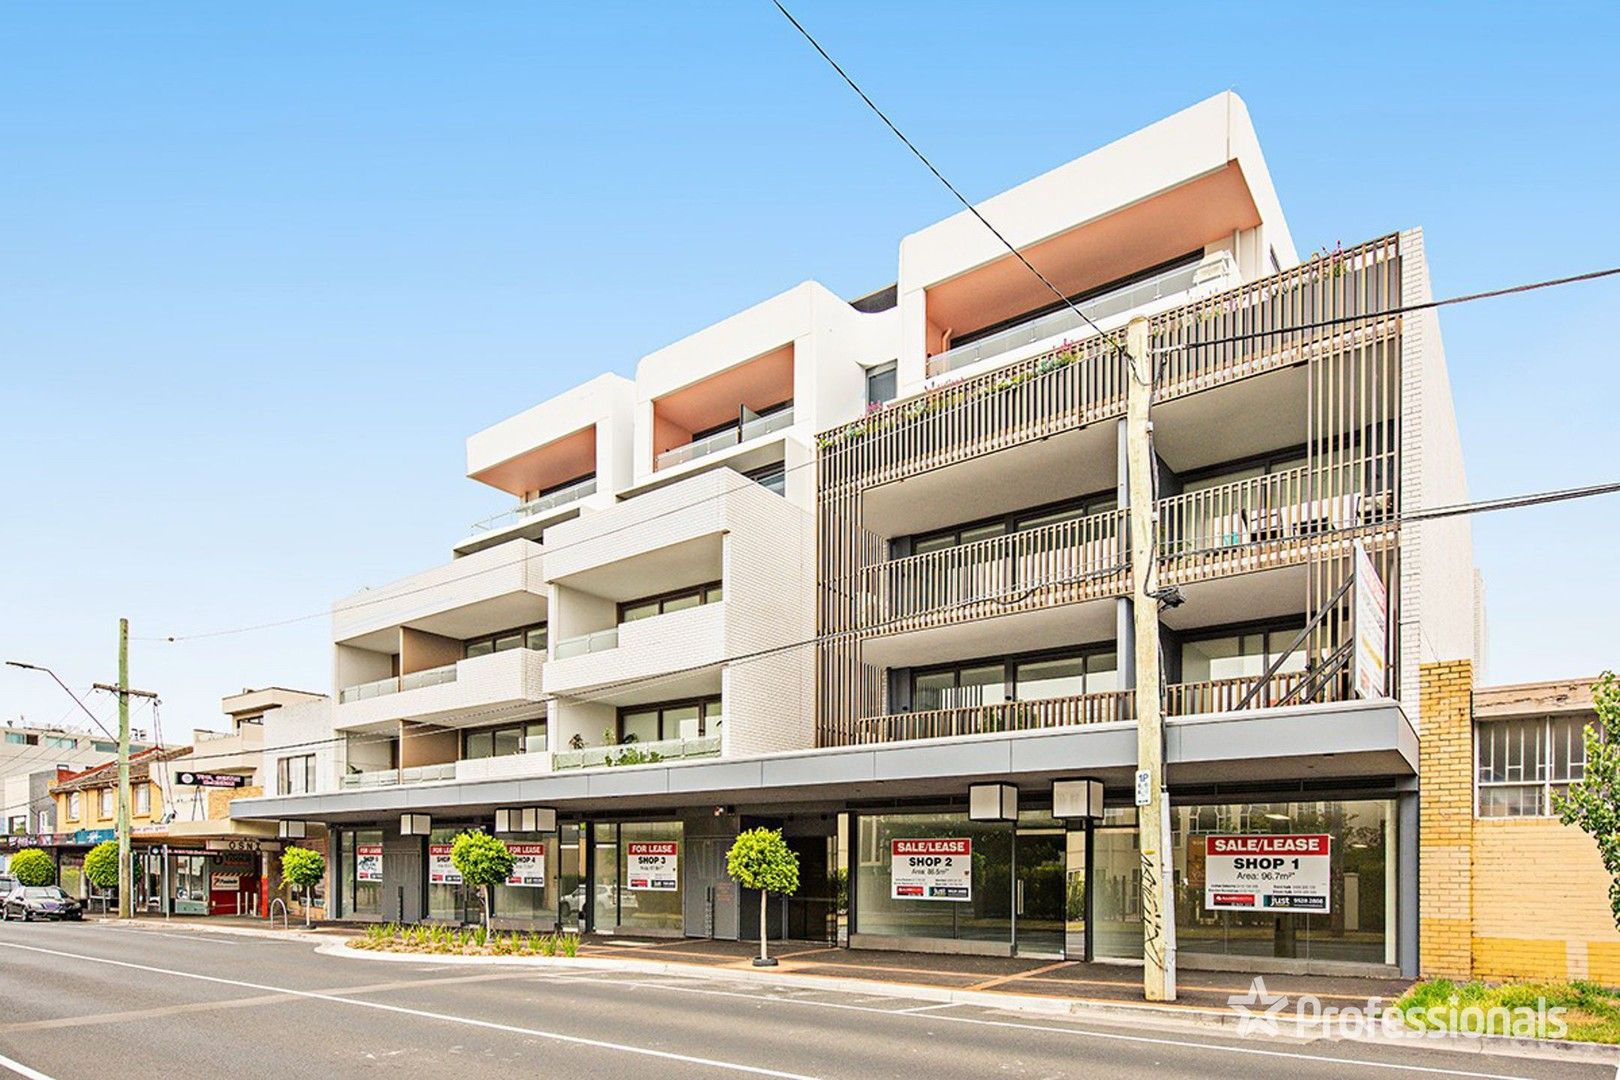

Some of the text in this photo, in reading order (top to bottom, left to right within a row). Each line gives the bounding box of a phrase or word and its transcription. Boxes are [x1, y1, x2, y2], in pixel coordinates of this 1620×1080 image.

[509, 846, 541, 854] FOR LEASE
[631, 845, 673, 853] FOR LEASE
[897, 842, 965, 853] SALE/LEASE
[1215, 838, 1320, 853] SALE/LEASE
[638, 856, 666, 865] SHOP 3
[909, 857, 953, 867] SHOP 2
[1233, 857, 1300, 870] SHOP 1
[1236, 872, 1260, 881] Area:
[1270, 895, 1290, 907] just
